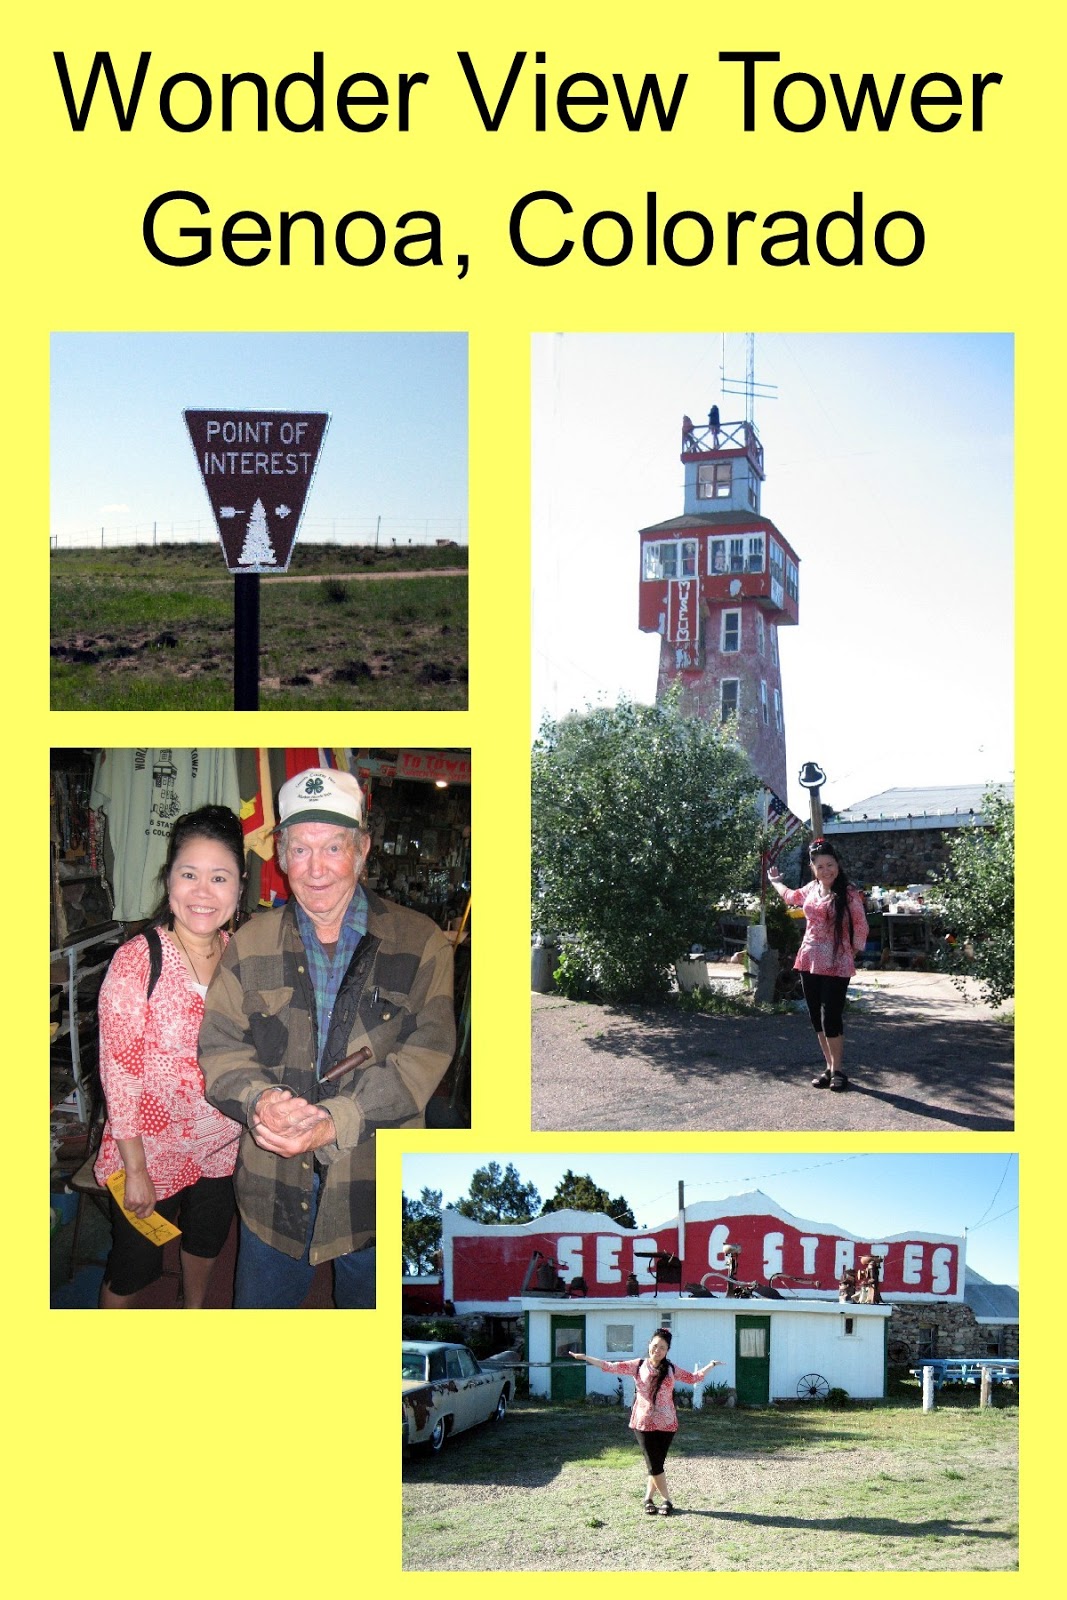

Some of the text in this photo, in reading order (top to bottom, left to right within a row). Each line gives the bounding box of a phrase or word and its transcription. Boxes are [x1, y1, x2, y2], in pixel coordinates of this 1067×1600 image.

[206, 420, 309, 445] POINT OF
[204, 451, 312, 475] INTEREST
[676, 580, 690, 641] MUSEUM
[402, 753, 422, 769] TO
[708, 1224, 730, 1271] 6
[763, 1232, 952, 1293] STATES
